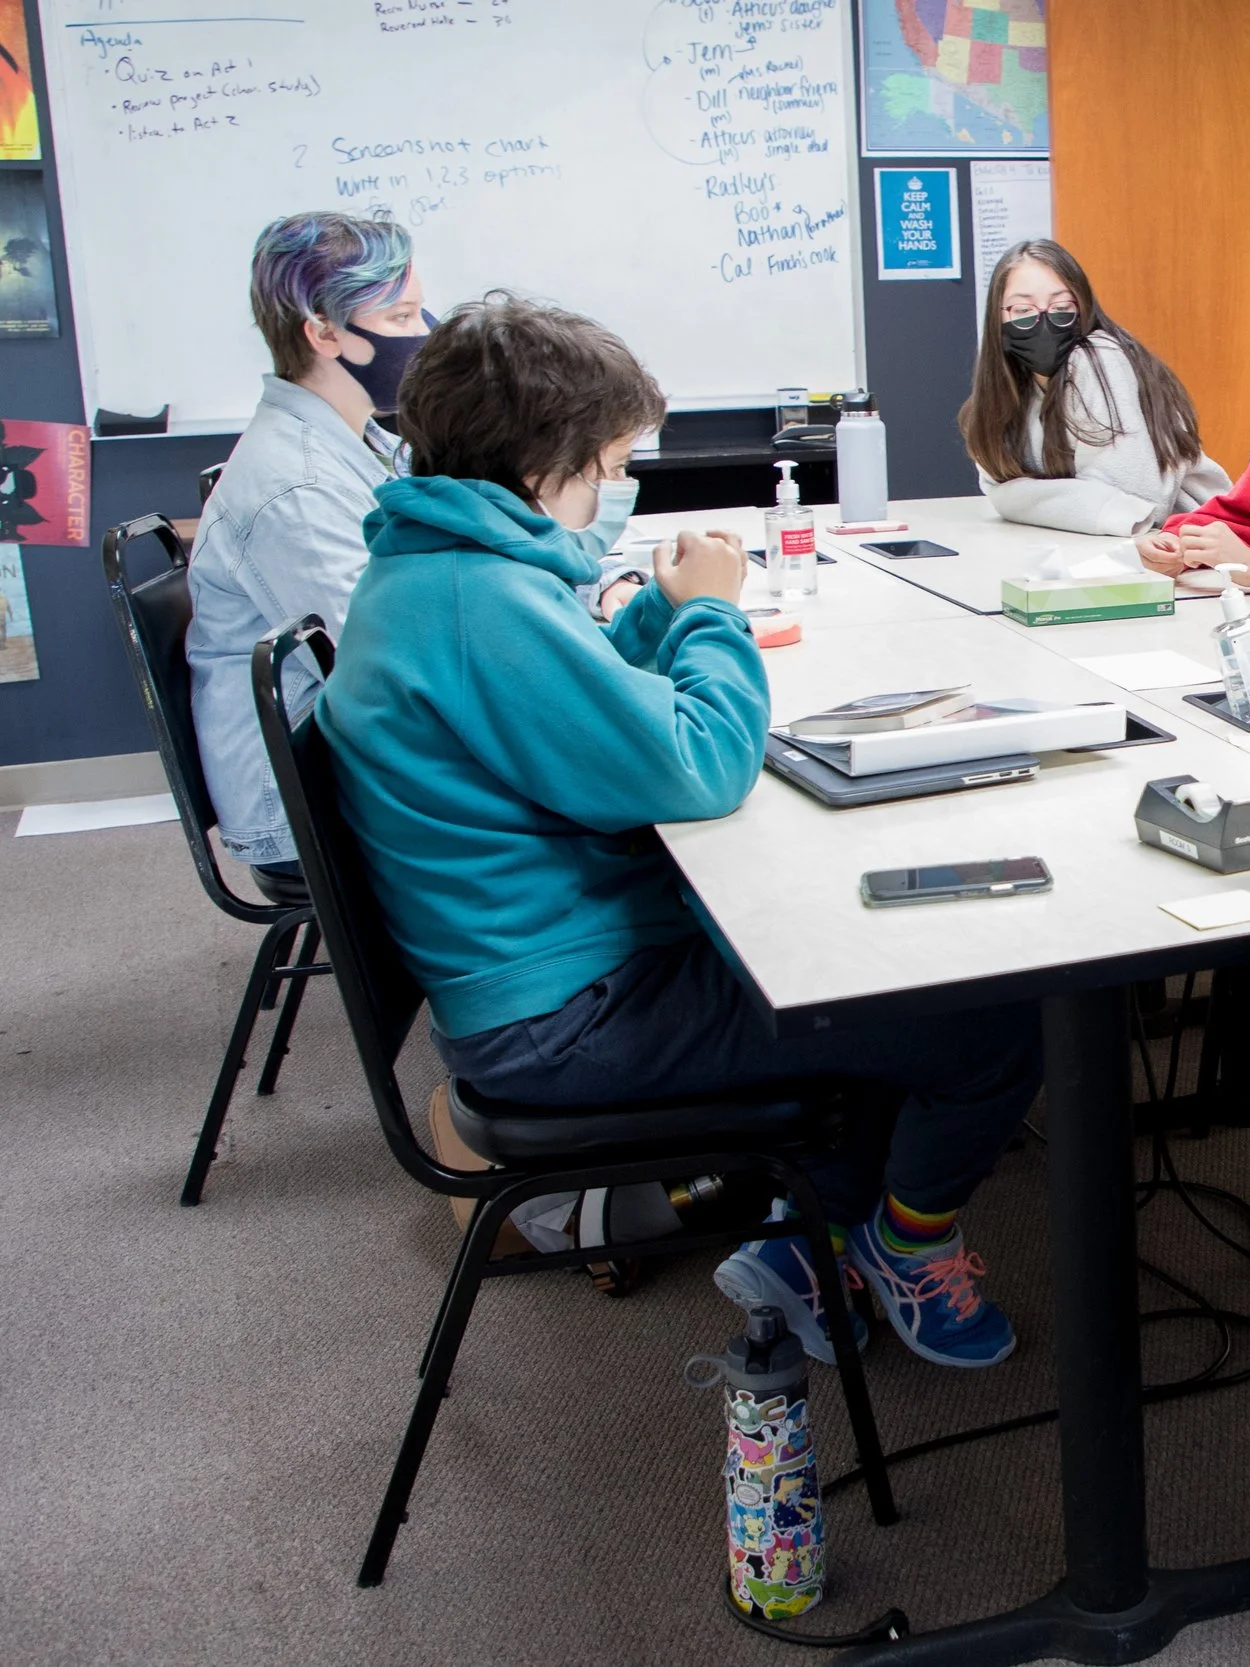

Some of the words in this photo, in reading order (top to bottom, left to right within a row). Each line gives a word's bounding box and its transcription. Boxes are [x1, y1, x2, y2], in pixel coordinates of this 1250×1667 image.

[80, 29, 142, 58] Agenda
[687, 42, 733, 64] Jem
[115, 56, 173, 84] Quiz
[212, 61, 237, 73] Act
[697, 88, 727, 112] Dill
[194, 118, 218, 130] Act
[701, 129, 756, 148] Atticus
[332, 137, 471, 164] Screenshot
[485, 136, 550, 157] chart
[901, 202, 931, 212] CALM
[903, 192, 928, 201] KEEP
[737, 222, 803, 248] Nathan
[900, 220, 933, 229] WASH
[902, 230, 932, 240] YOUR
[898, 240, 937, 251] HANDS
[721, 253, 753, 282] Cal
[68, 429, 84, 540] CHARACTER
